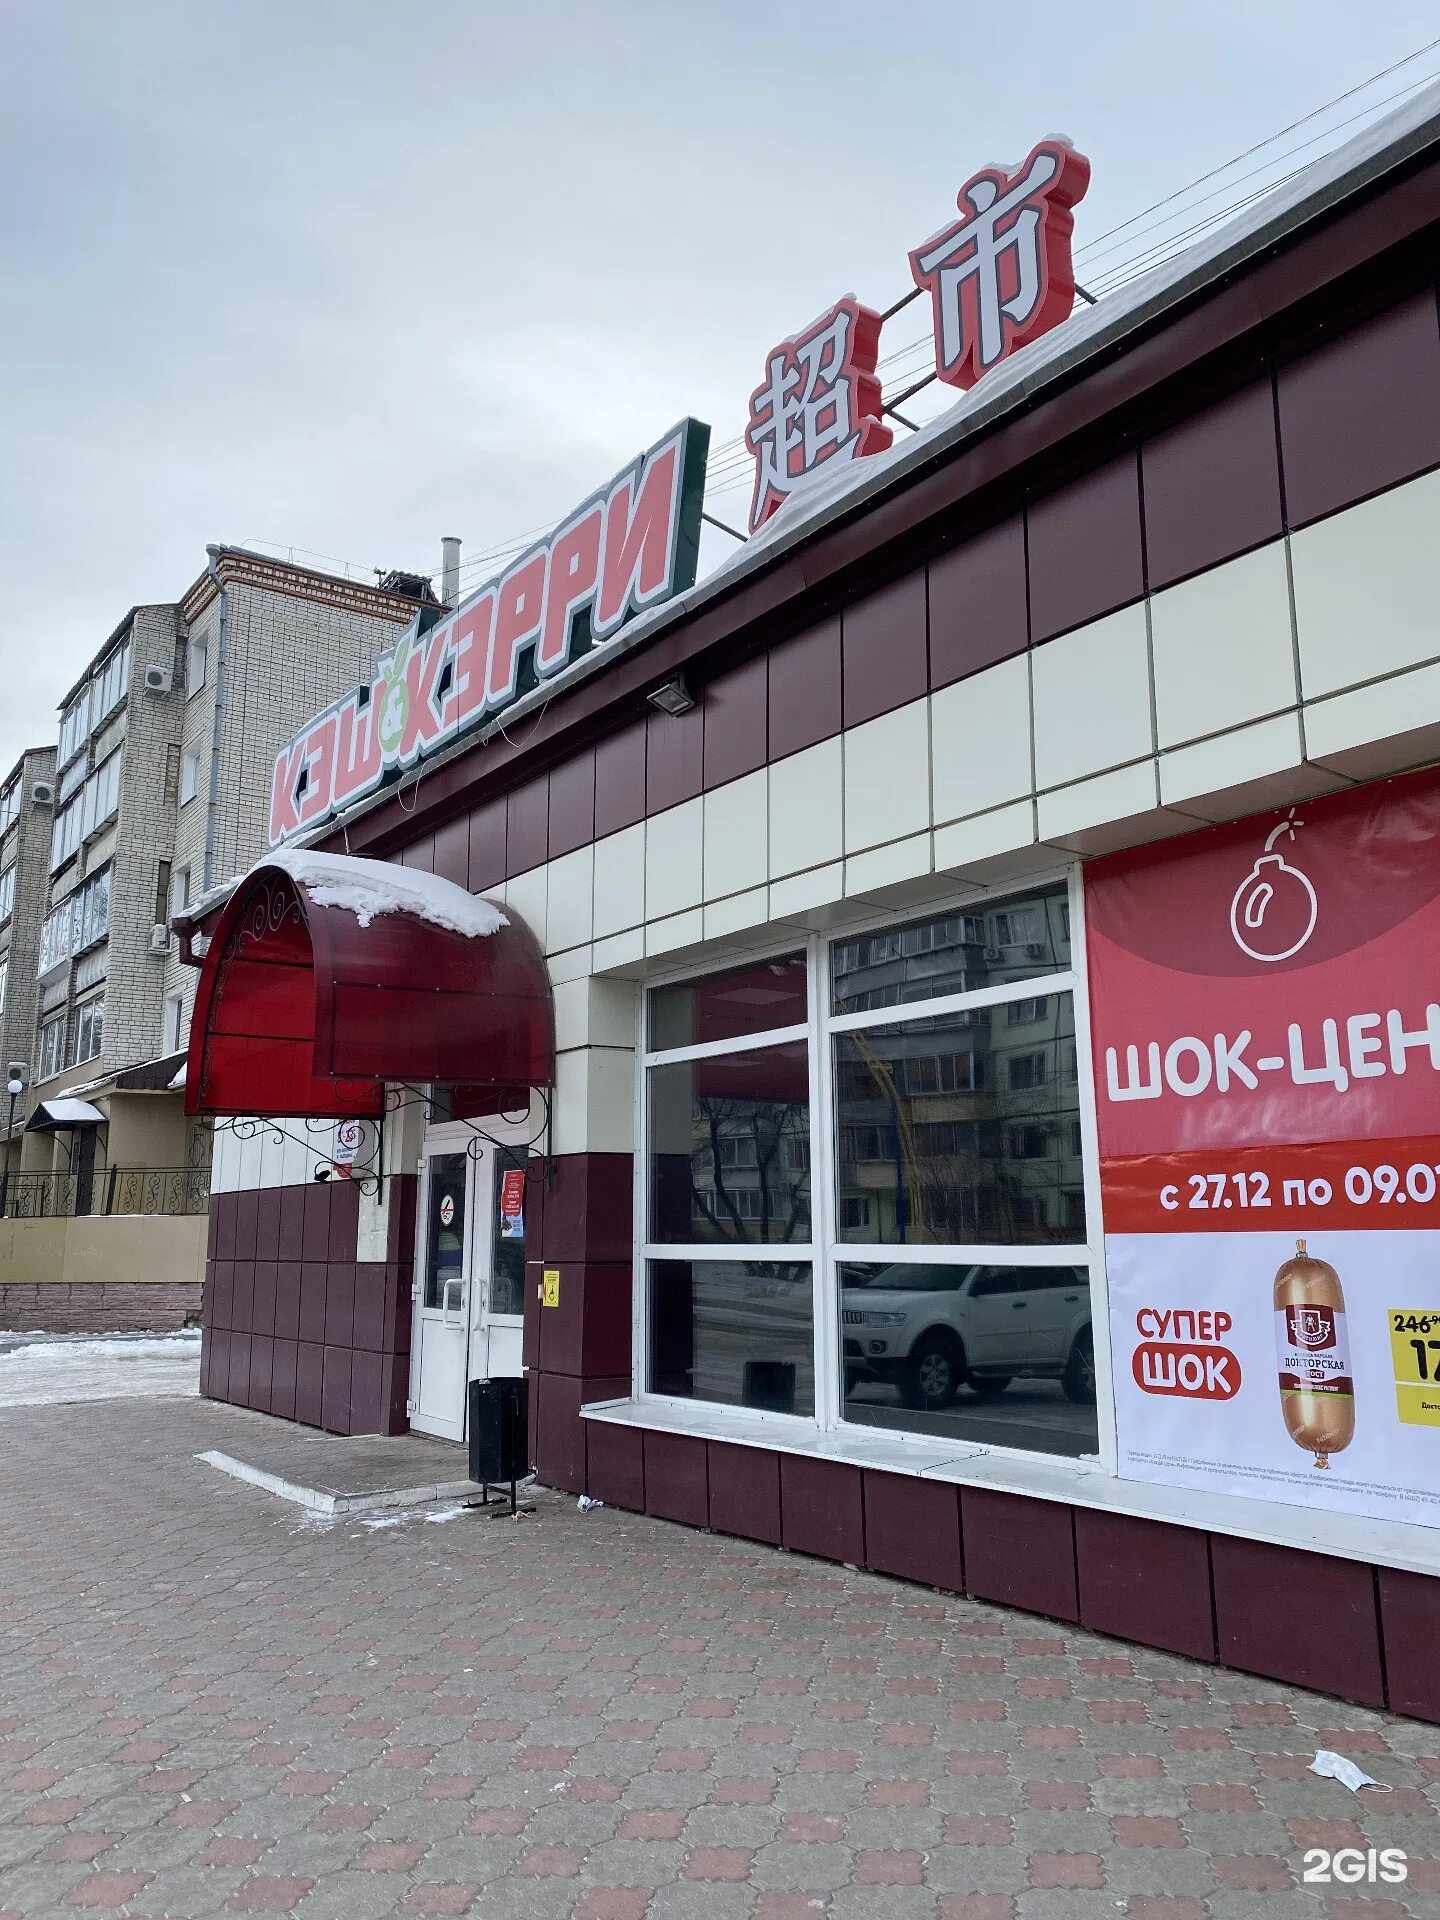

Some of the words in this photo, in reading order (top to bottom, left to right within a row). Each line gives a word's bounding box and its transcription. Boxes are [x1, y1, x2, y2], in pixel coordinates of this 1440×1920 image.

[1105, 1003, 1440, 1103] ШОК-ЦЕН
[1159, 1180, 1180, 1211] с
[1187, 1170, 1272, 1210] 27.12
[1283, 1177, 1333, 1207] по
[1343, 1162, 1440, 1207] 09.0
[1135, 1307, 1233, 1342] СУПЕР
[1141, 1350, 1233, 1394] ШОК
[1285, 1357, 1345, 1371] ДОКТОРСКАЯ
